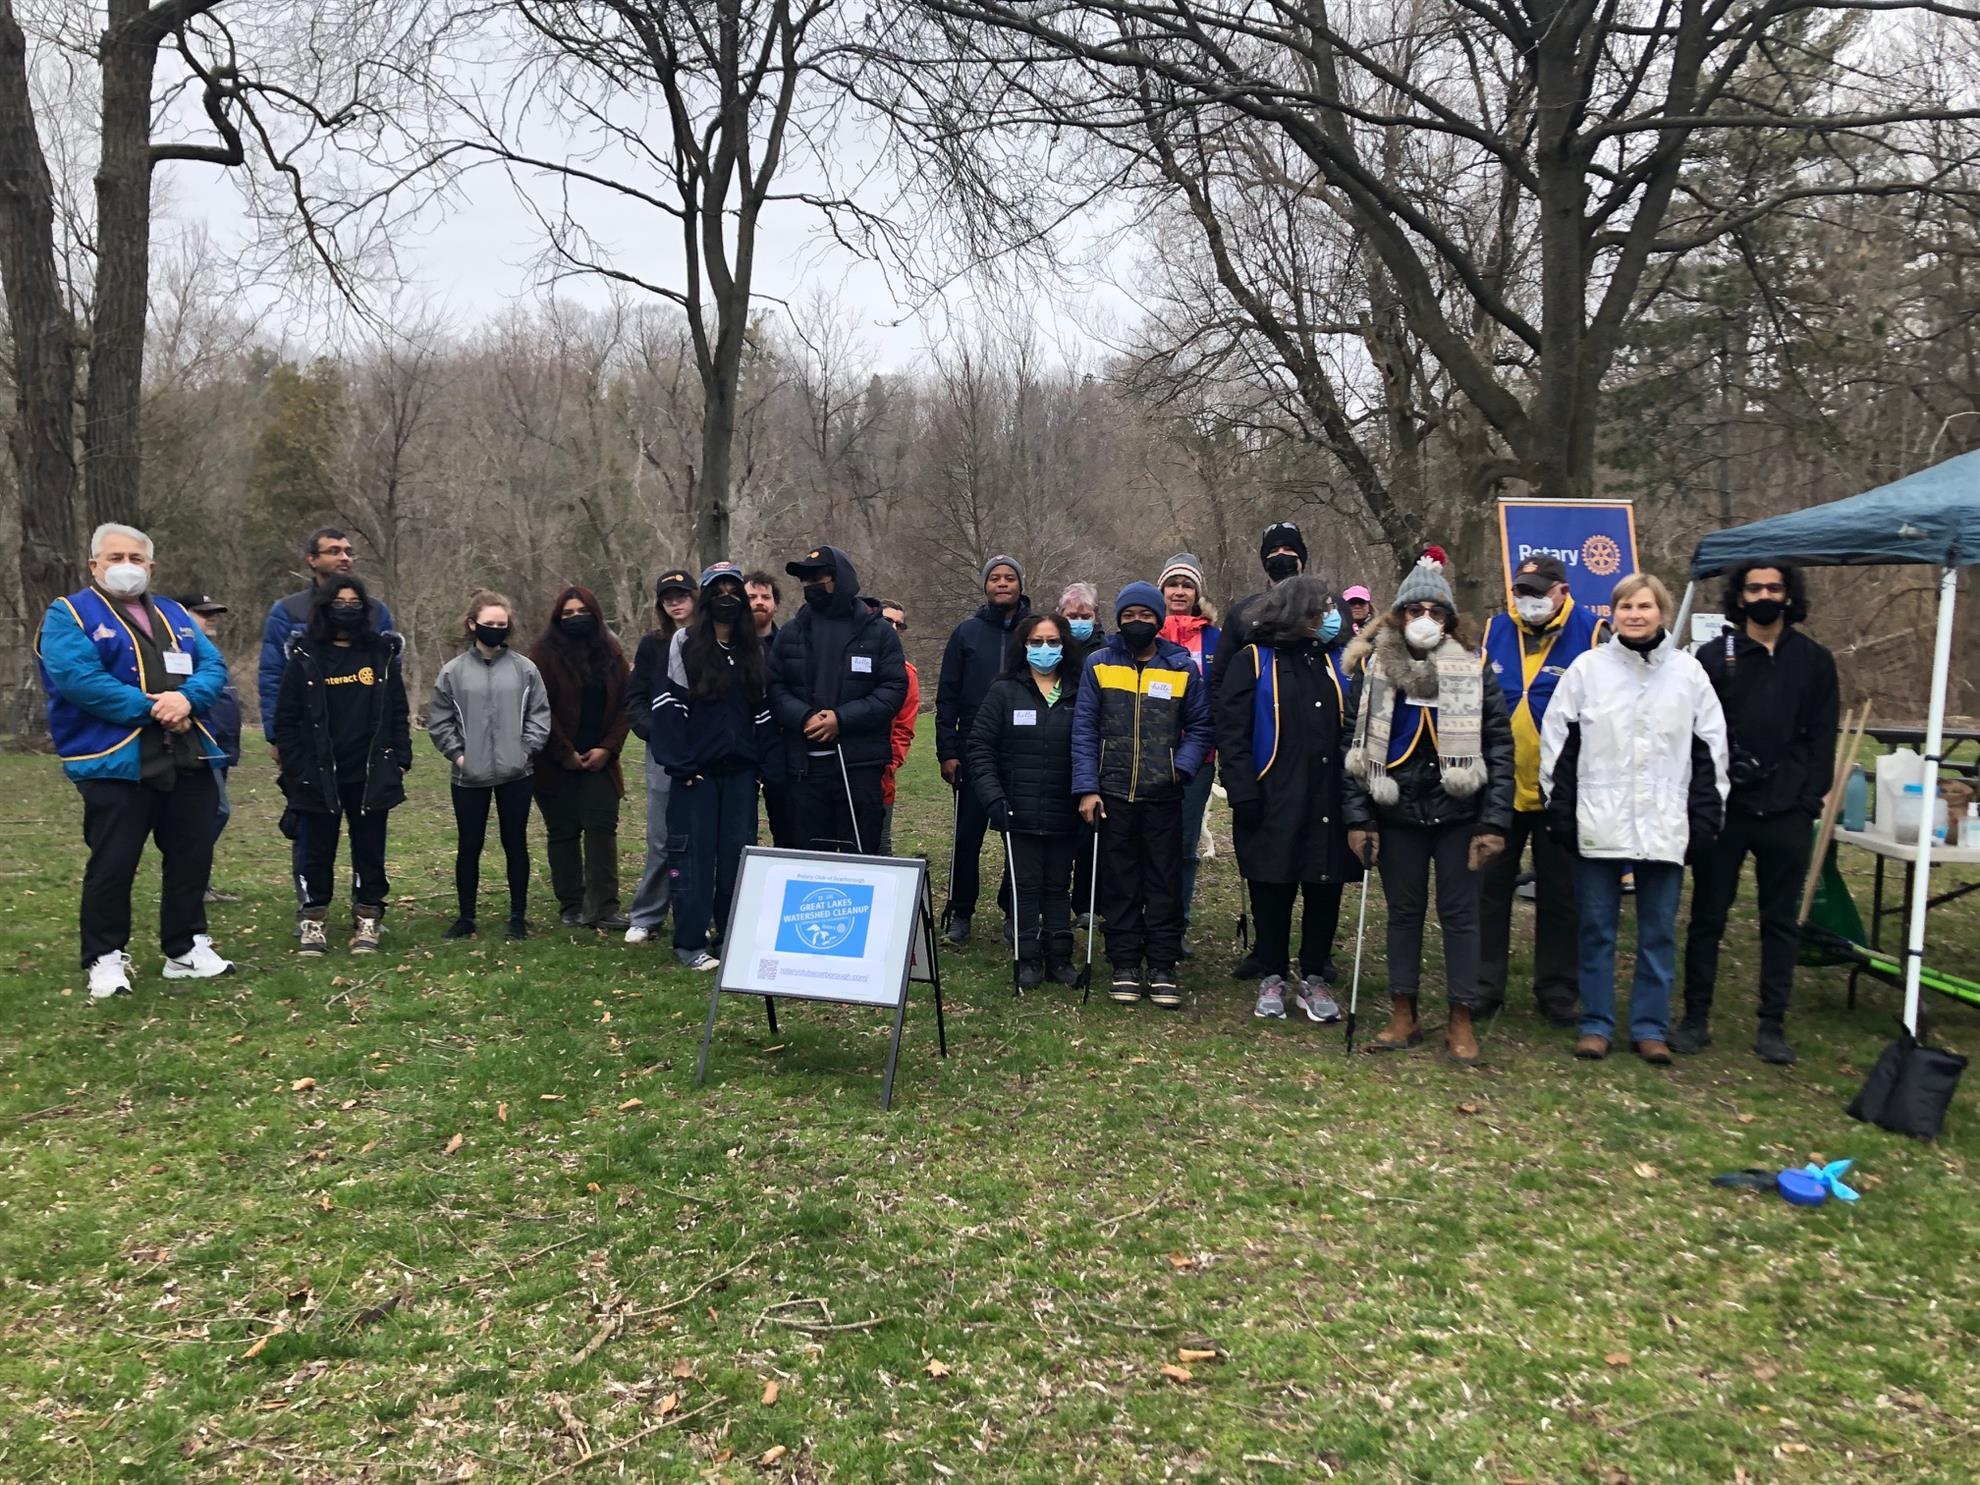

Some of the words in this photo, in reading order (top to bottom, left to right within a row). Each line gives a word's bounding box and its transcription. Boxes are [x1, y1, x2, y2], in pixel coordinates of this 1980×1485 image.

[324, 674, 358, 685] nteract
[800, 902, 825, 912] GREAT
[827, 899, 853, 909] LAKES
[783, 910, 831, 923] WATERSHED
[832, 905, 870, 917] CLEANUP
